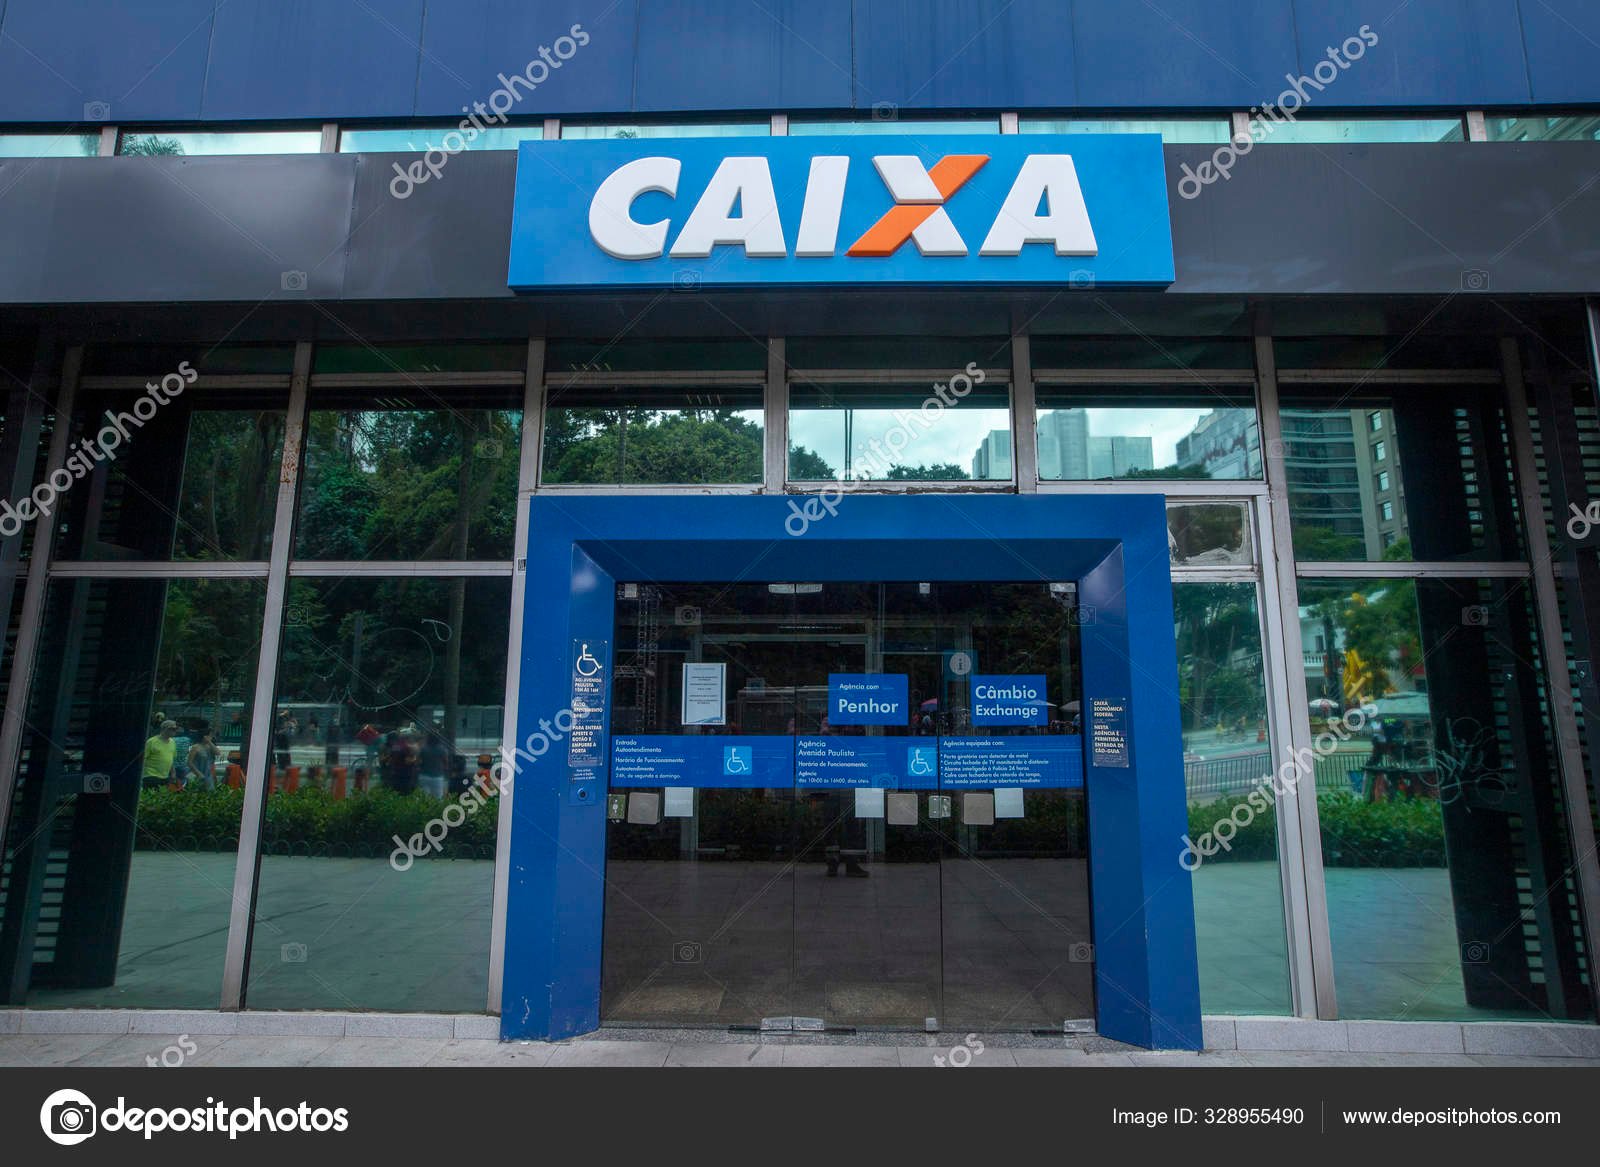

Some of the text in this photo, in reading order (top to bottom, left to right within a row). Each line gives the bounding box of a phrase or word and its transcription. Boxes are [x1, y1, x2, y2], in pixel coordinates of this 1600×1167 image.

[588, 154, 1098, 260] CAIXA
[840, 683, 865, 691] Agência
[975, 685, 1037, 700] Câmbio
[839, 698, 899, 713] Penhor
[975, 704, 1039, 719] Exchange
[798, 740, 826, 749] Agência
[944, 740, 965, 748] Agência
[798, 749, 855, 757] Avenida Paulista
